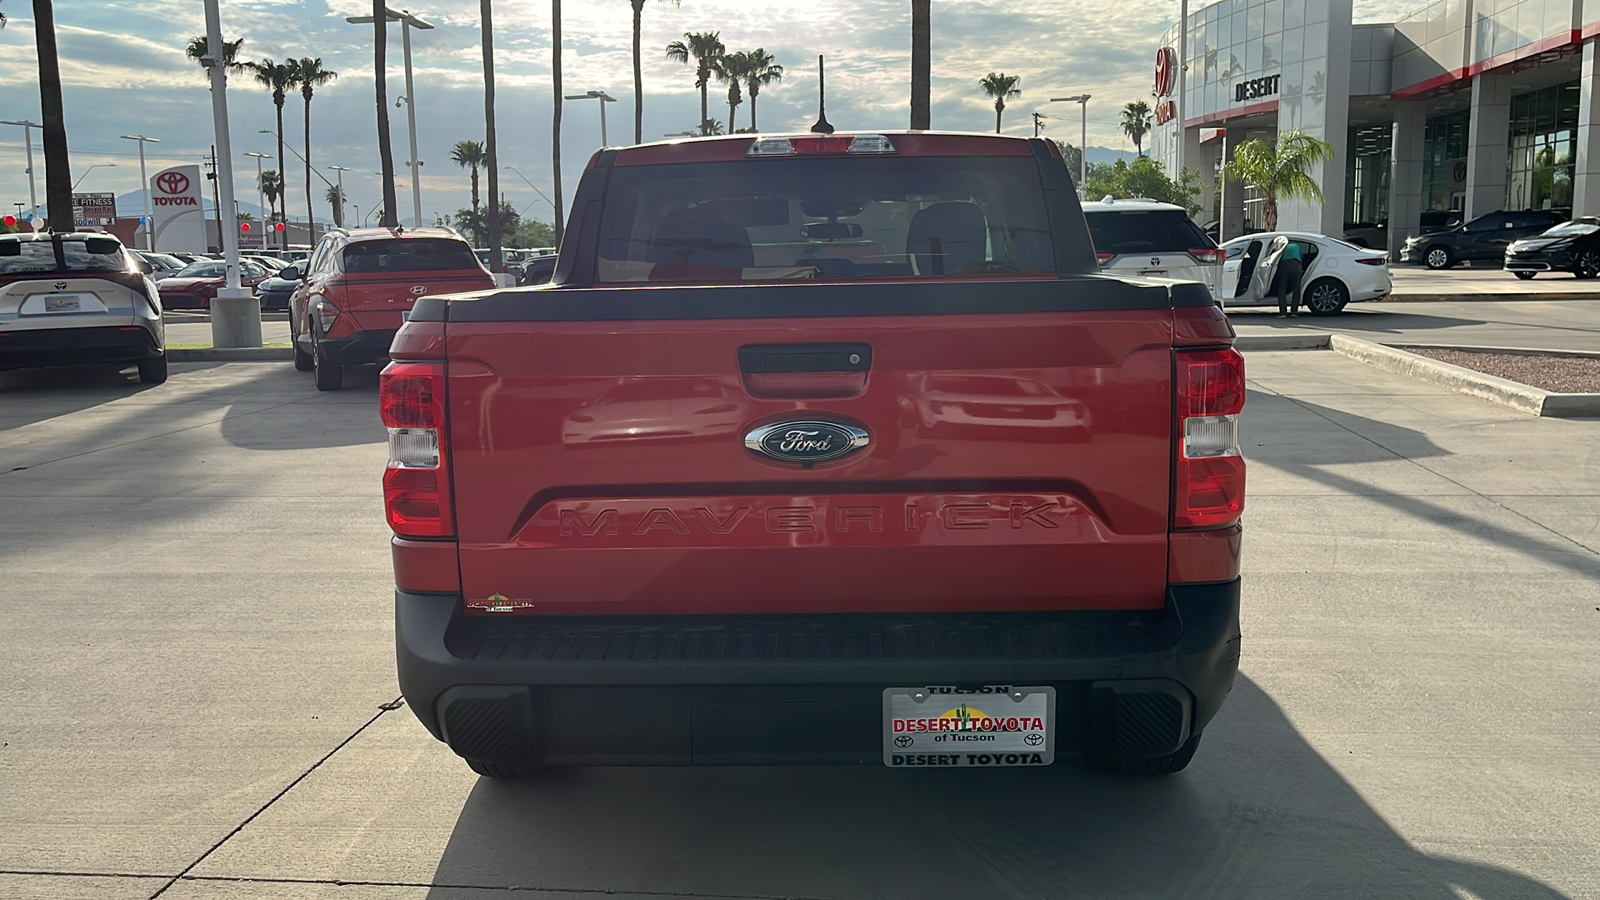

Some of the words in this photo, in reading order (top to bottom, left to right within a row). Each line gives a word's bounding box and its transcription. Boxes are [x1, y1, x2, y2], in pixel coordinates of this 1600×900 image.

[1235, 74, 1281, 102] DESERT
[81, 198, 113, 206] FITNESS
[152, 196, 198, 206] TOYOTA
[74, 217, 100, 226] oodwill
[780, 430, 832, 452] Ford
[559, 502, 1061, 536] MAVERICK
[893, 718, 962, 732] DESERT
[969, 717, 1044, 731] TOYOTA
[934, 734, 948, 742] of
[951, 734, 996, 742] Tucson
[892, 754, 960, 766] DESERT
[967, 753, 1043, 765] TOYOTA
